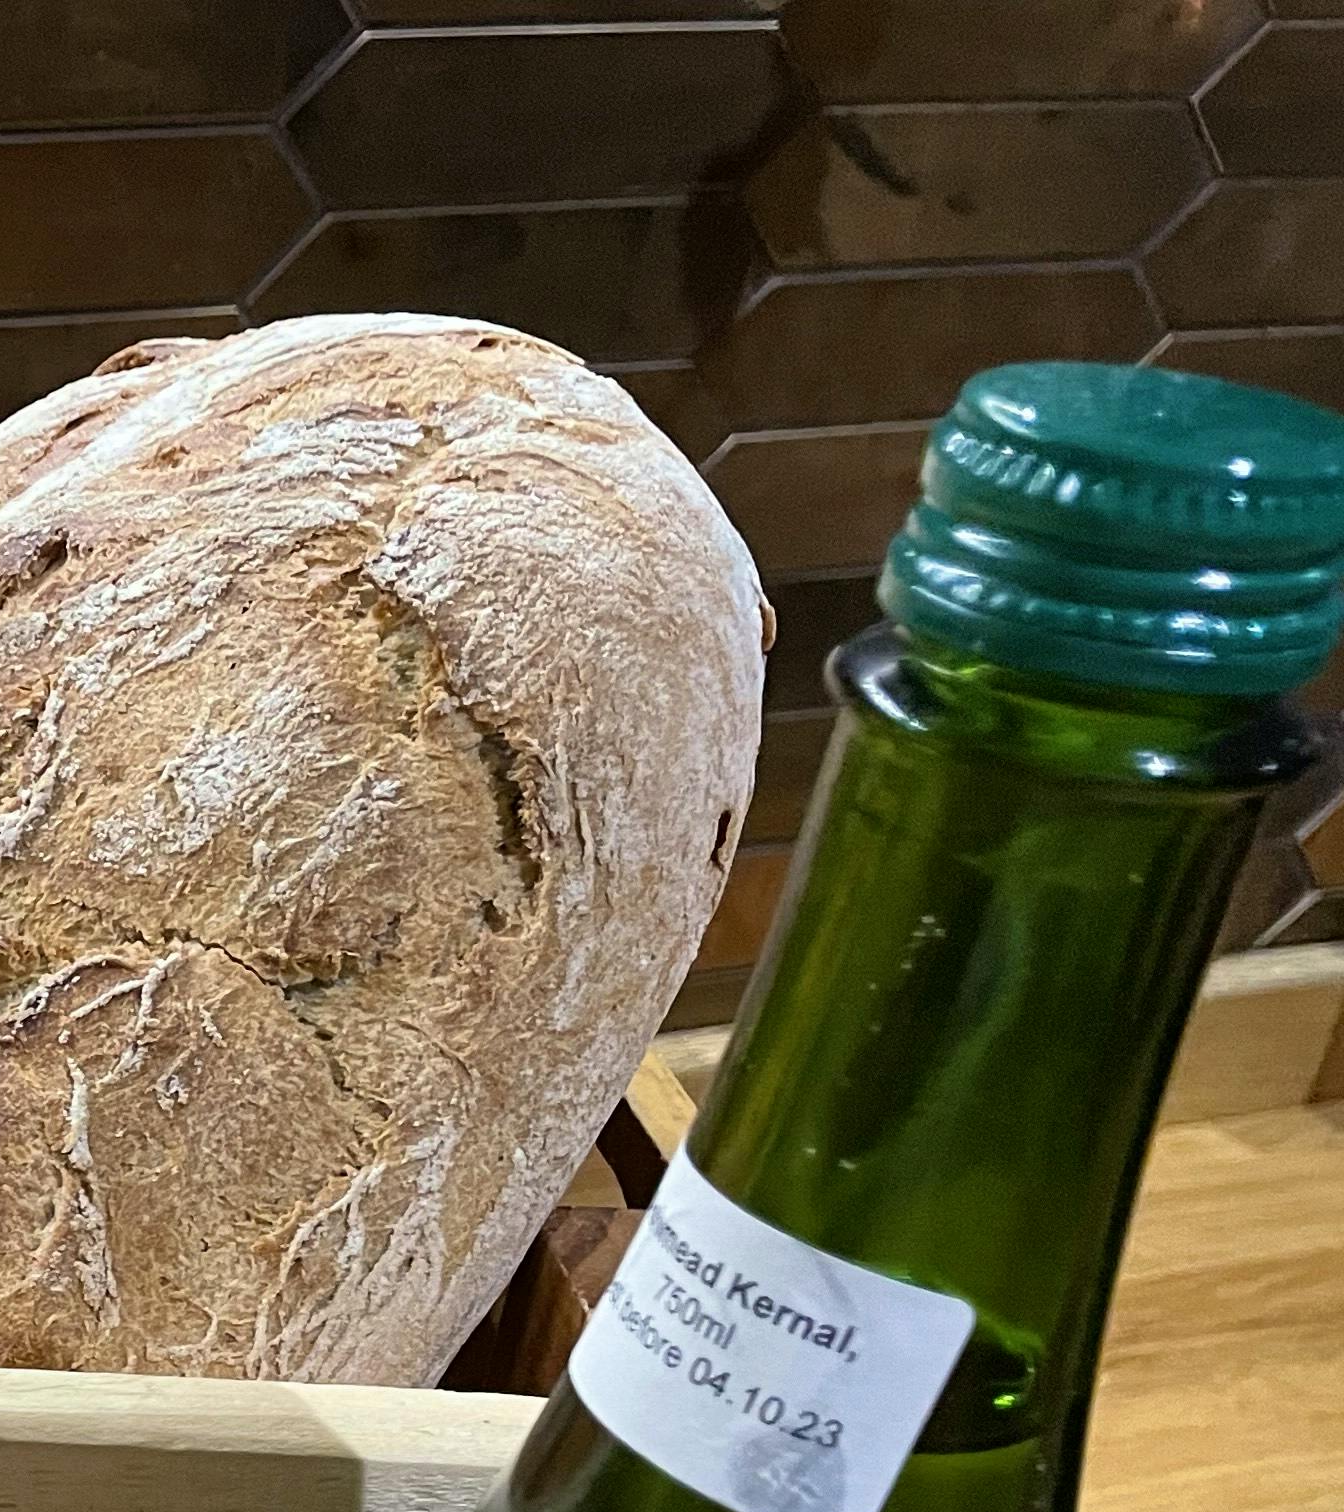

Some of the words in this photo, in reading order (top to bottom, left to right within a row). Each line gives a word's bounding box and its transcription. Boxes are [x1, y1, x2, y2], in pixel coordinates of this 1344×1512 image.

[652, 1273, 737, 1350] 750ml
[726, 1271, 859, 1363] Kernal,
[688, 1356, 845, 1449] 04.10.23
